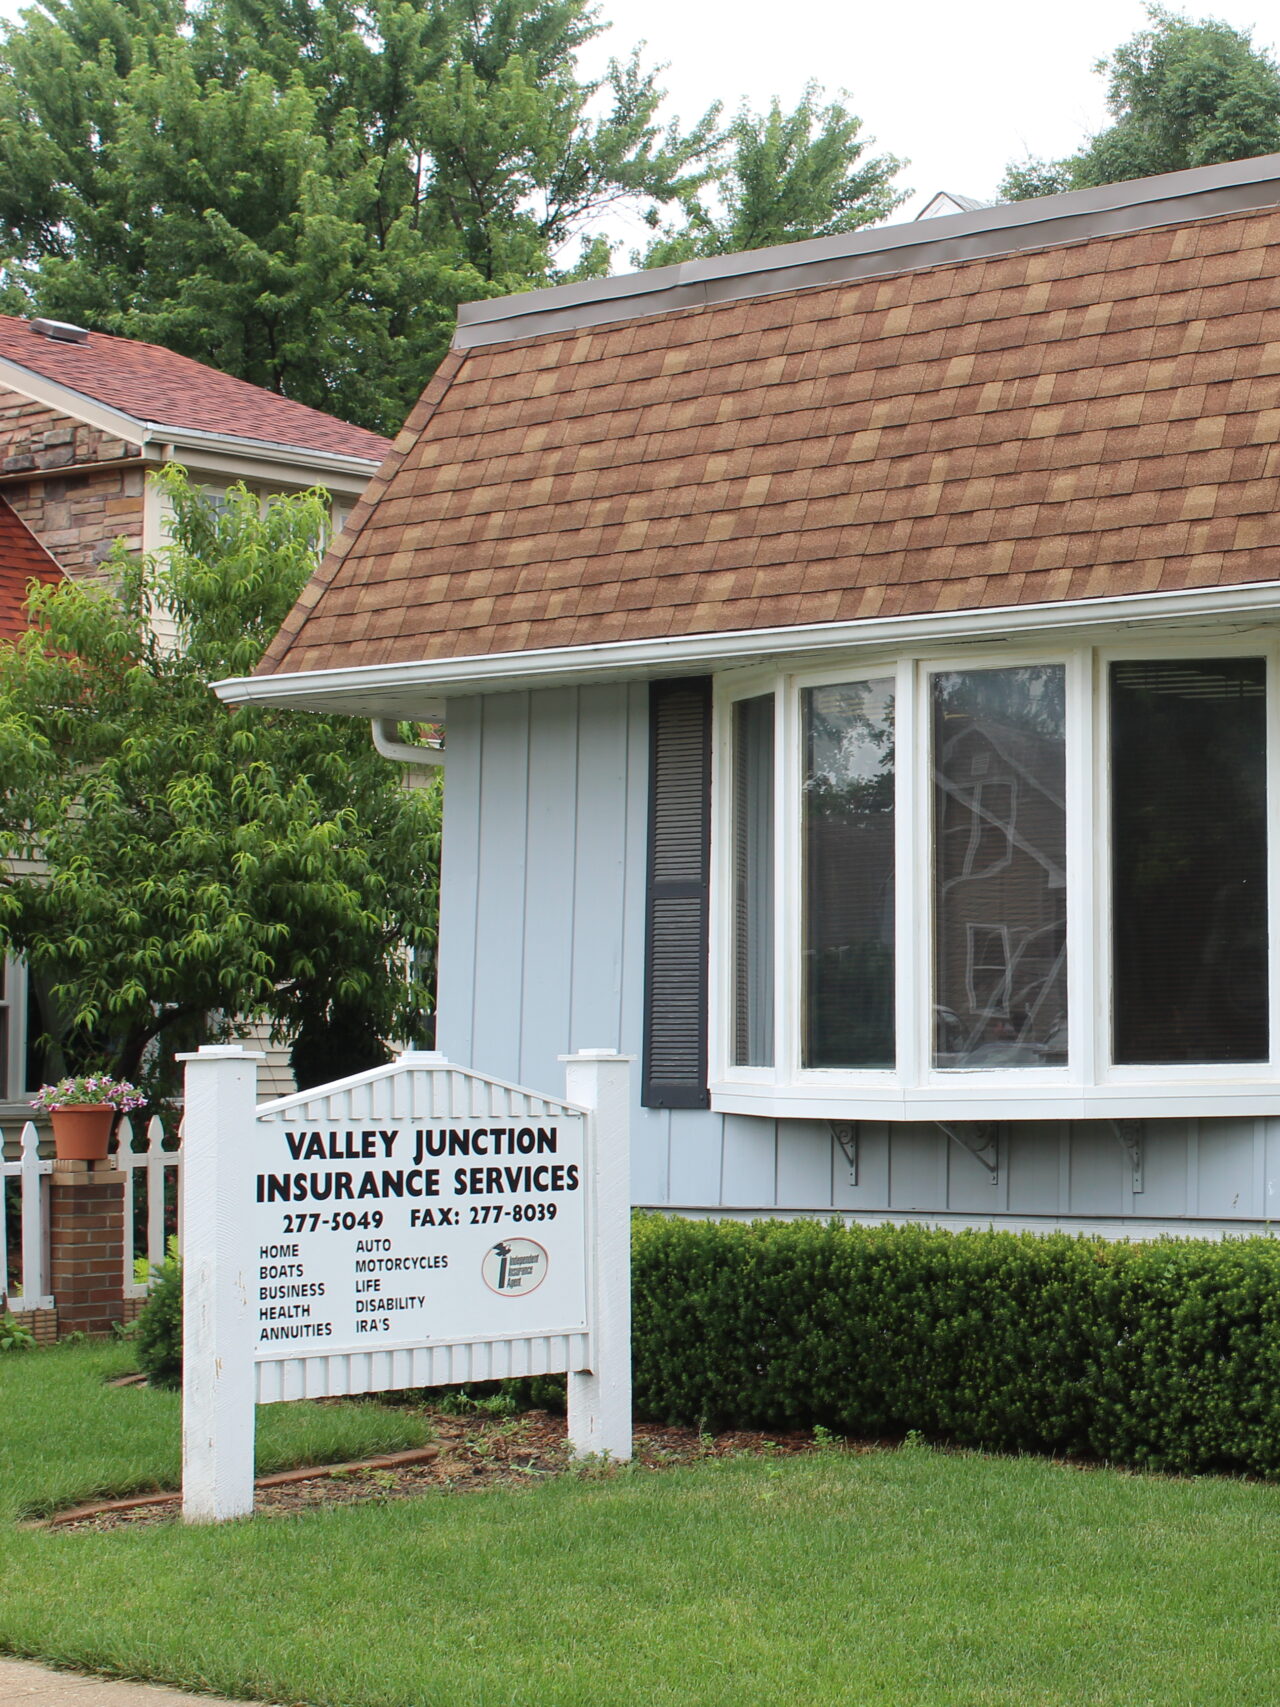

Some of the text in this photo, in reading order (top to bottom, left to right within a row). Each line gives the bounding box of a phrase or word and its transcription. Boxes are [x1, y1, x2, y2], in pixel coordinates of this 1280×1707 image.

[284, 1127, 558, 1166] VALLEY JUNCTION
[256, 1164, 579, 1203] INSURANCE SERVICES
[282, 1210, 384, 1234] 277-5049
[410, 1202, 557, 1228] FAX: 277-8039
[259, 1243, 299, 1260] HOME
[355, 1238, 392, 1253] AUTO
[259, 1263, 304, 1280] BOATS
[355, 1255, 449, 1273] MOTORCYCLES
[259, 1282, 326, 1301] BUSINESS
[355, 1278, 381, 1294] LIFE
[259, 1303, 311, 1321] HEALTH
[355, 1295, 426, 1314] DISABILITY
[259, 1322, 333, 1342] ANNUITIES
[355, 1317, 390, 1334] IRA'S
